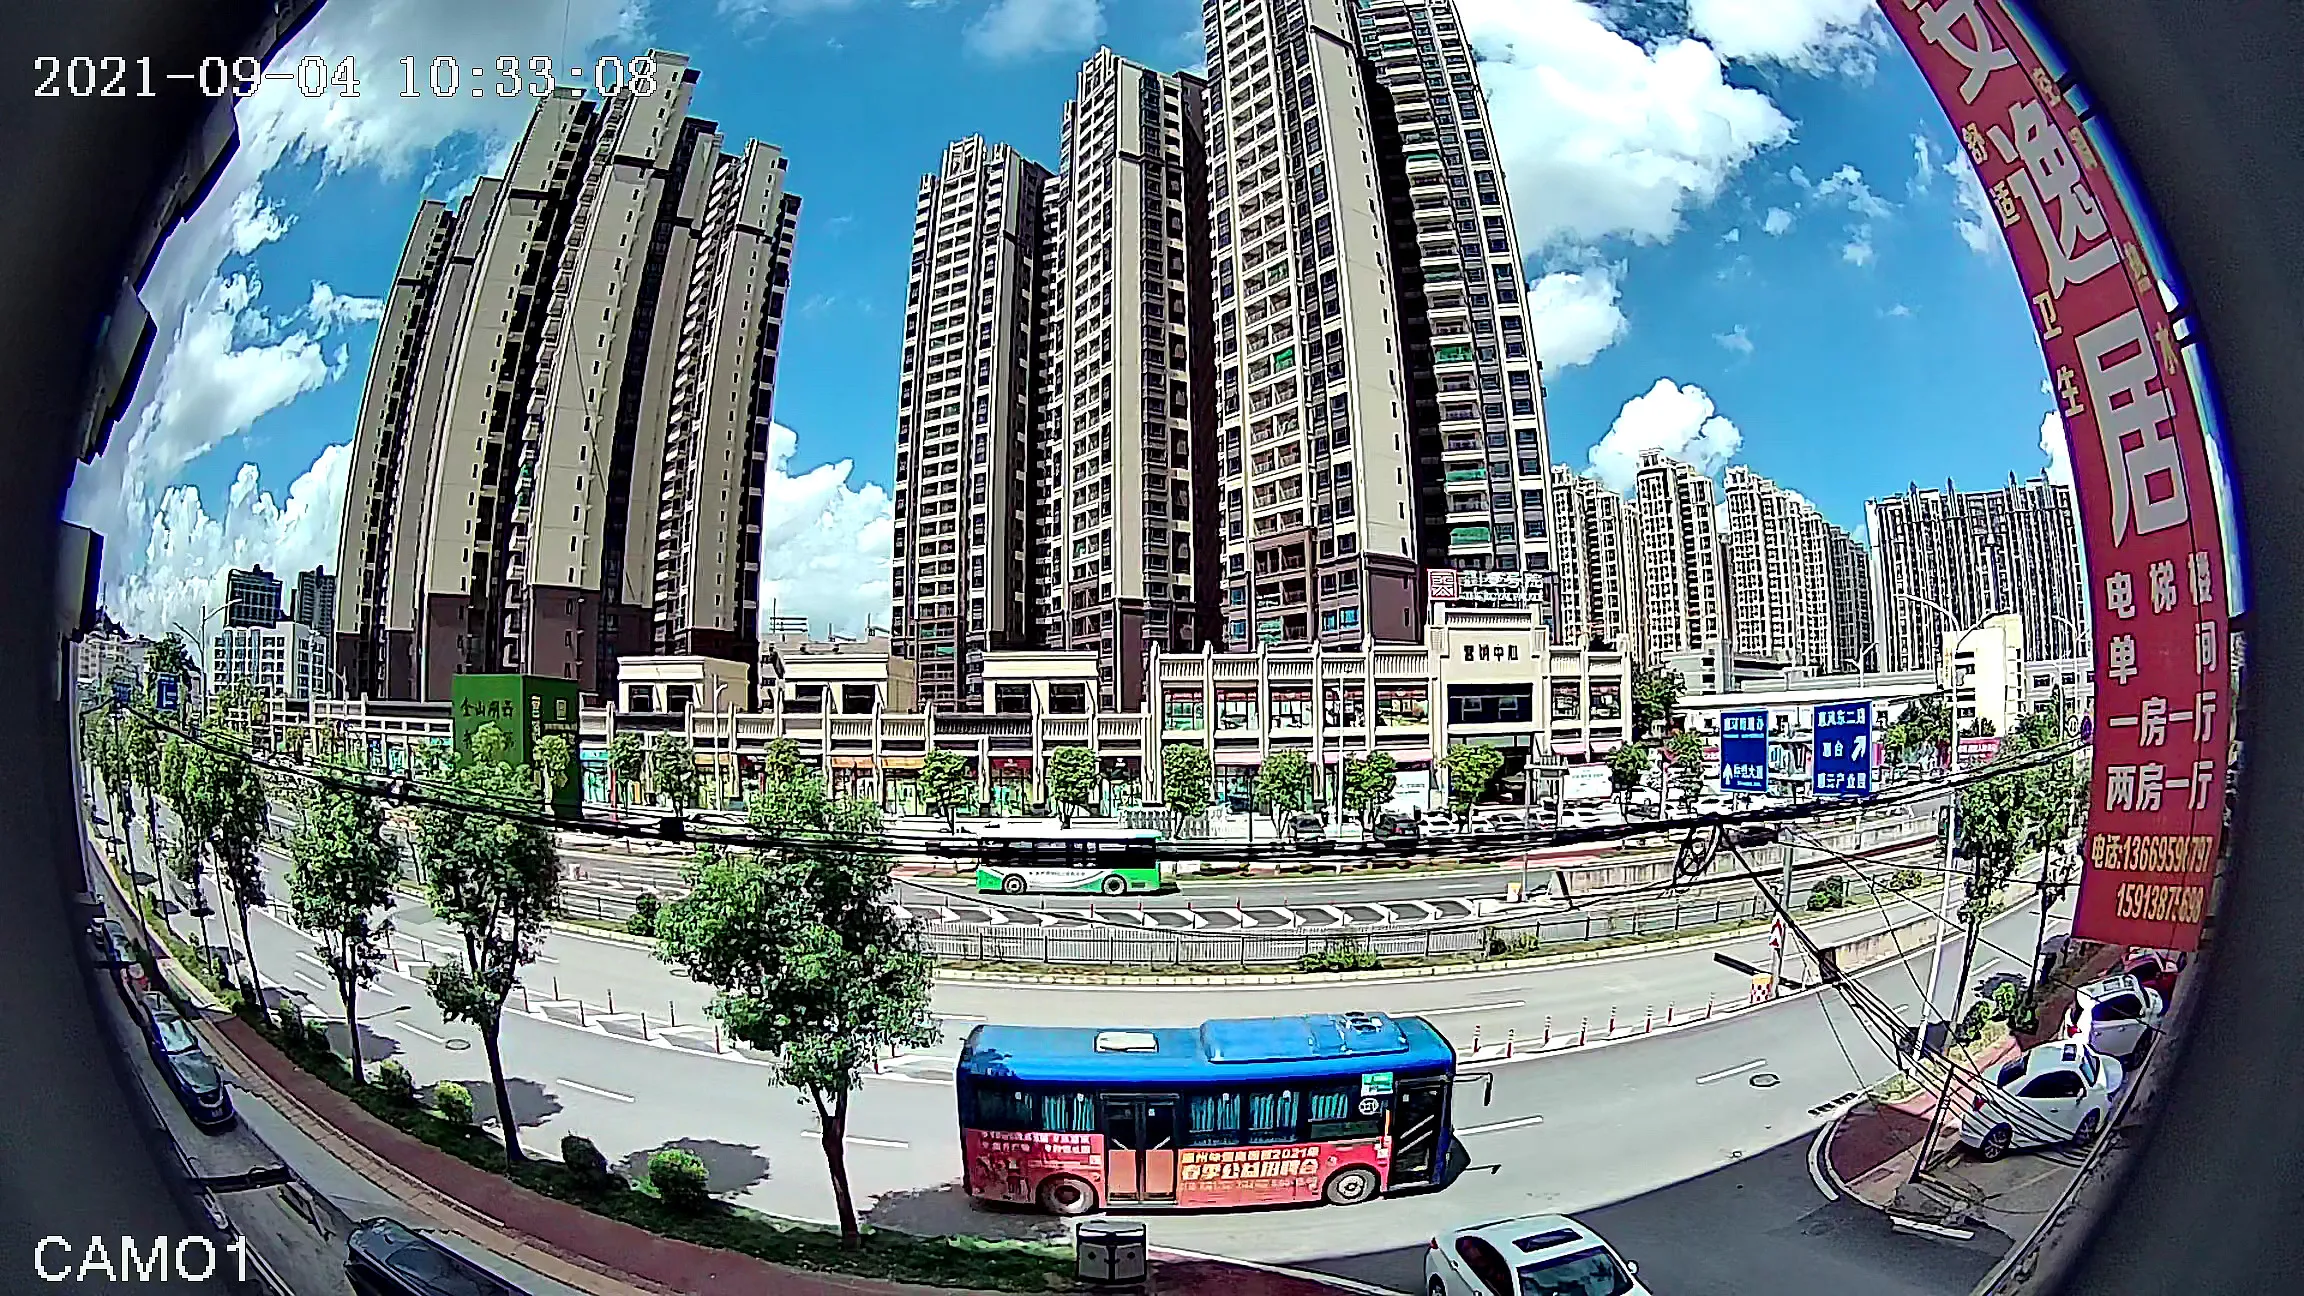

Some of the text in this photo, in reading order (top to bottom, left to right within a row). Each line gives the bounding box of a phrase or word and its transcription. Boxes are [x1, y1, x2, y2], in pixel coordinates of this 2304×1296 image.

[1961, 122, 2085, 417] 舒适卫生
[2110, 697, 2217, 749] 一房一厅
[2106, 760, 2214, 812] 两房一厅
